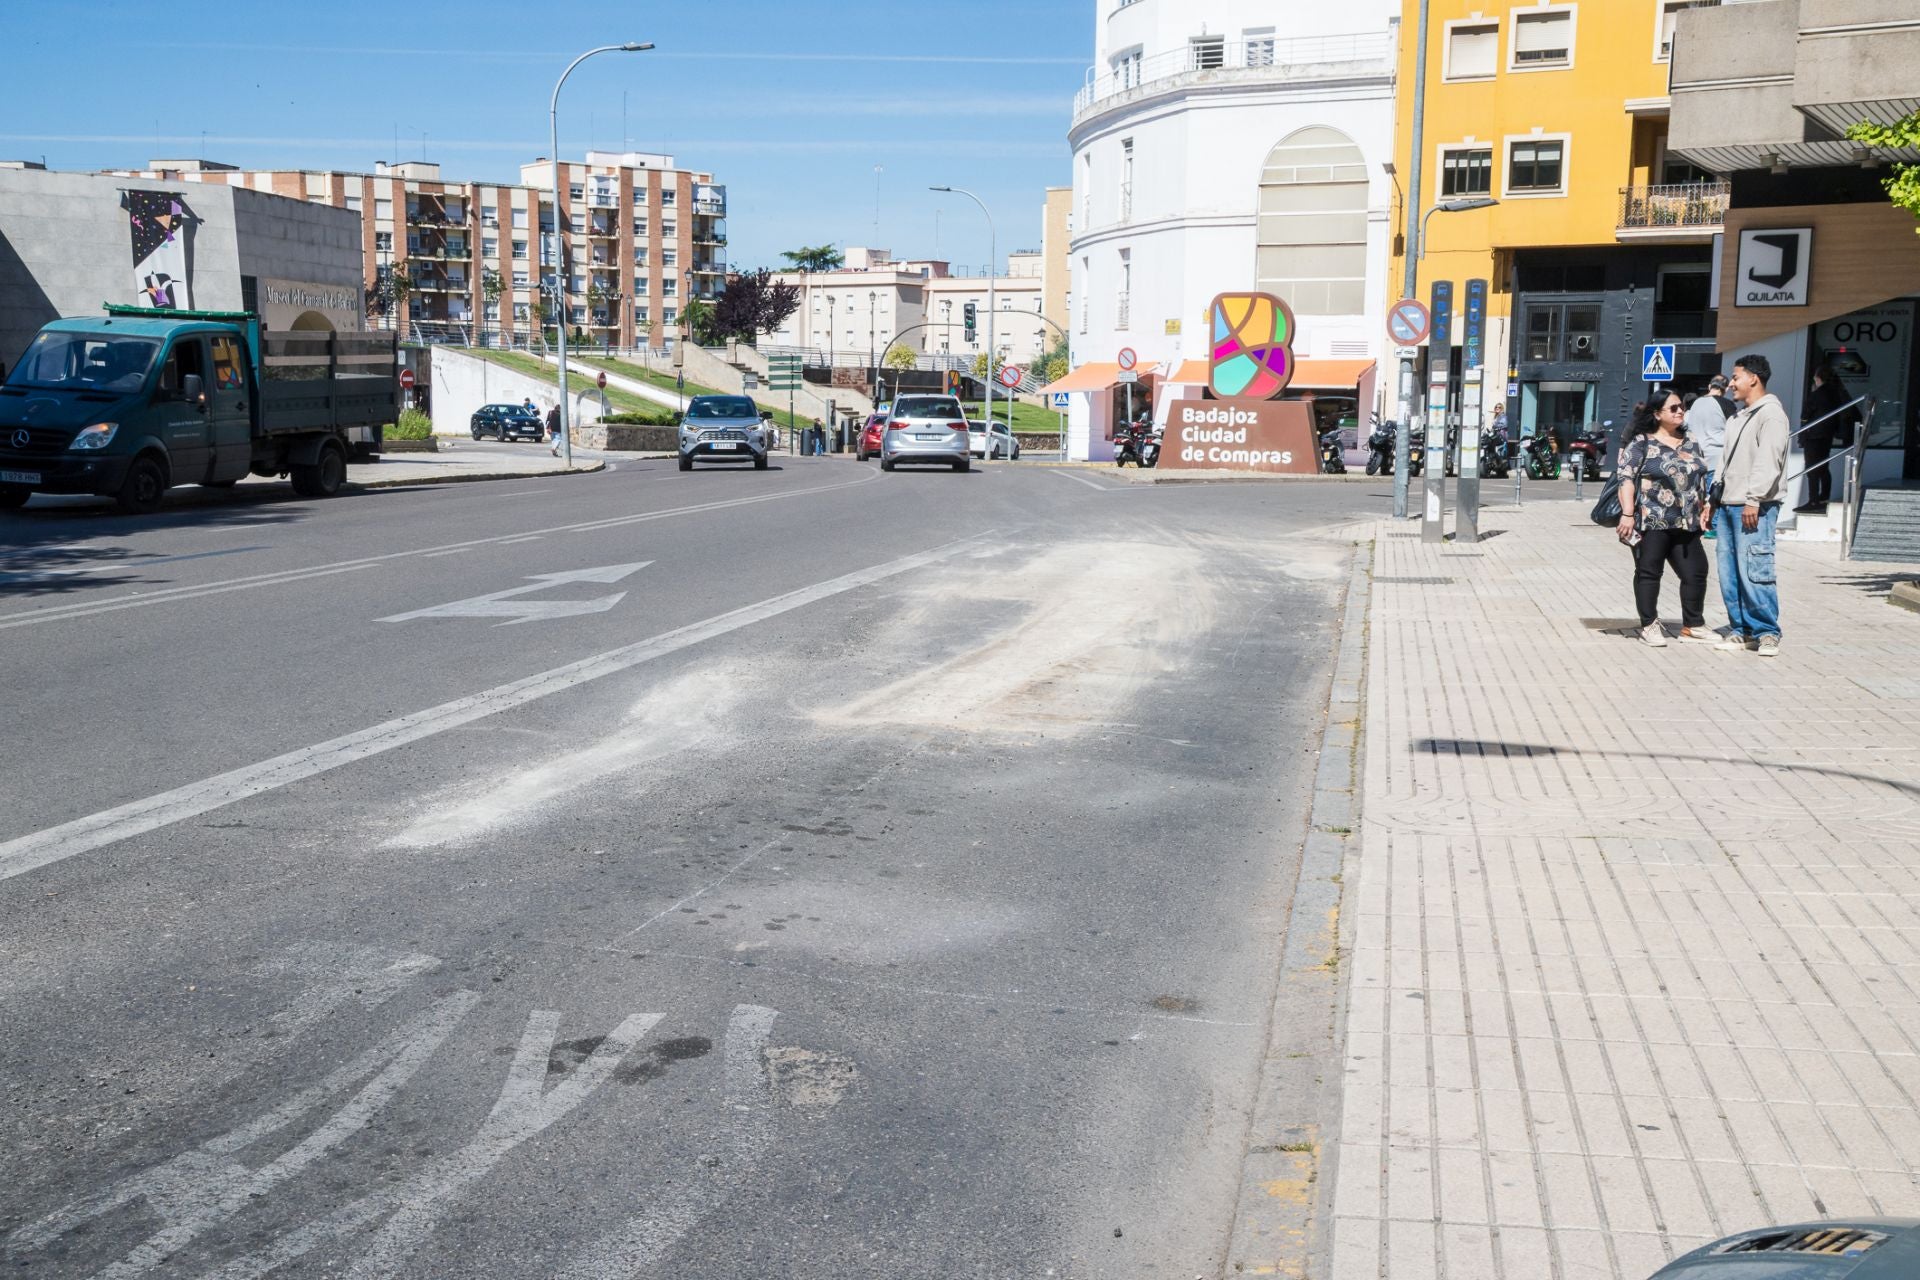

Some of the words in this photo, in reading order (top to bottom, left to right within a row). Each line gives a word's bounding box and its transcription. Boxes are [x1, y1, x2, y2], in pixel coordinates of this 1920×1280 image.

[266, 286, 290, 304] Museo
[1747, 292, 1795, 302] QUILATIA
[1833, 321, 1897, 342] ORO
[1182, 407, 1258, 427] Badajoz
[1181, 426, 1247, 443] Ciudad
[1181, 446, 1205, 462] de
[1208, 447, 1292, 466] Compras
